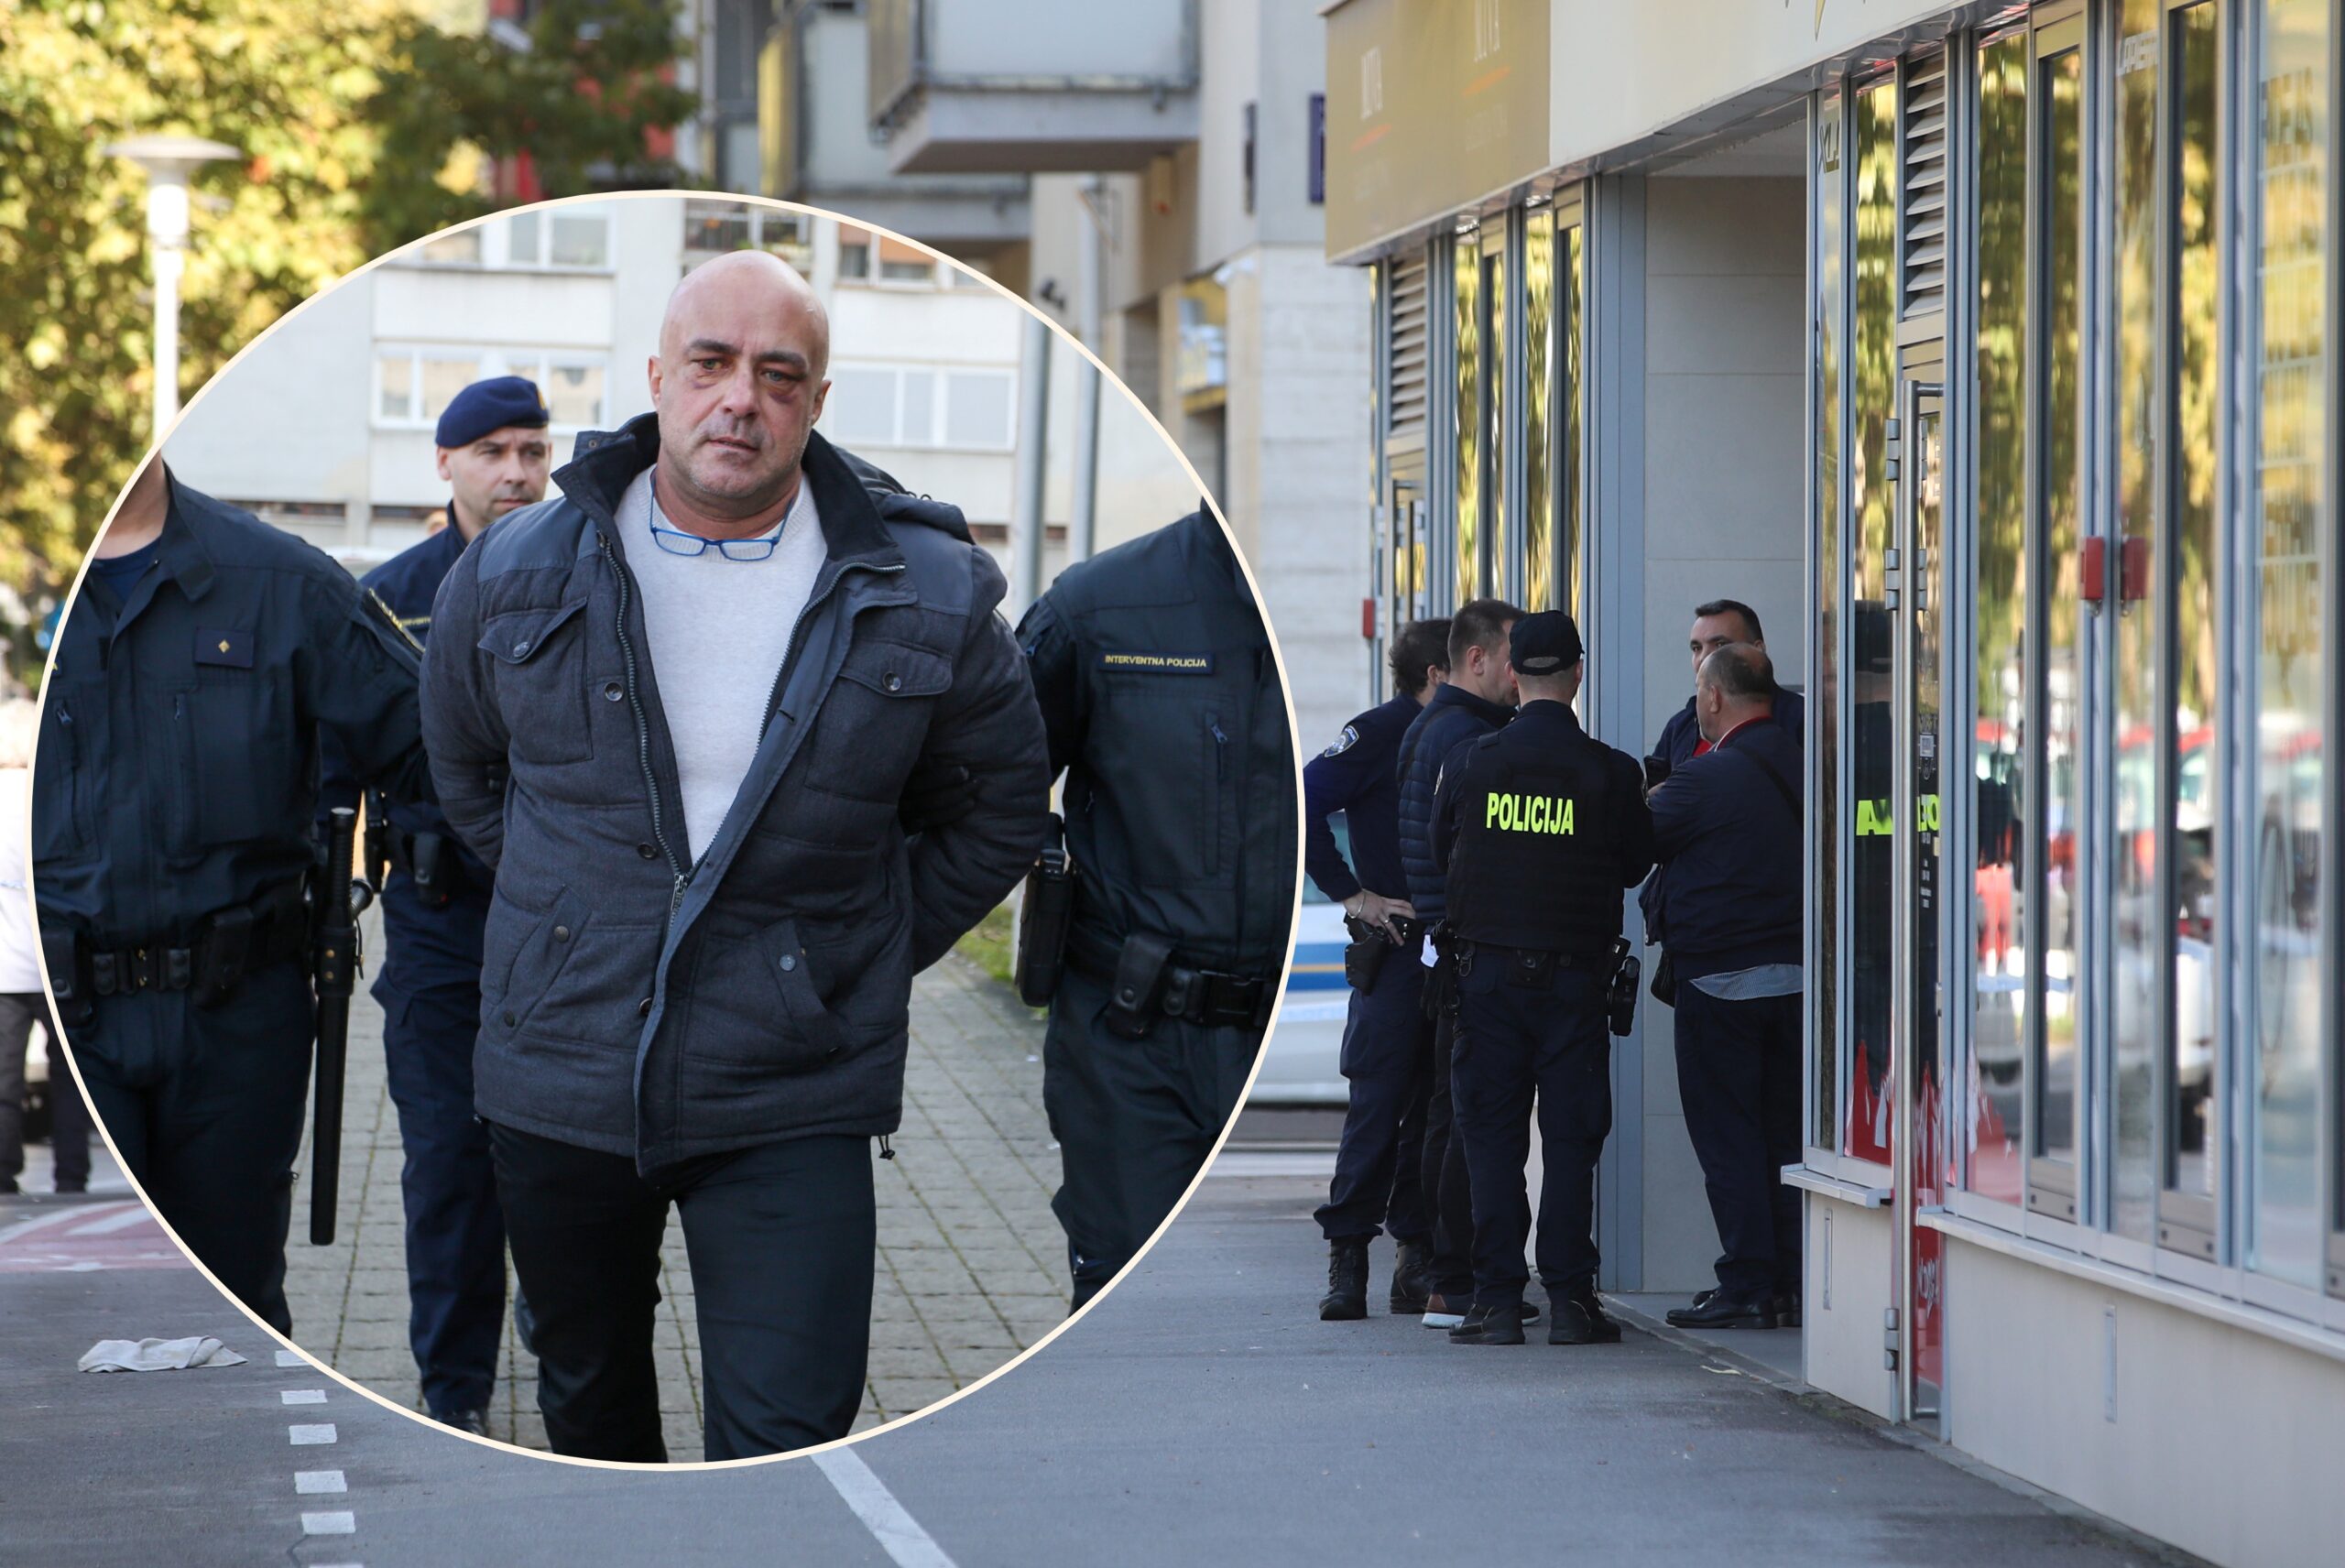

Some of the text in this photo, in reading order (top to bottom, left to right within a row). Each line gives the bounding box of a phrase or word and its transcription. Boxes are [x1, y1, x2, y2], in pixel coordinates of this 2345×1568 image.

[1105, 655, 1206, 667] INTERVENTNA POLICIJA
[1486, 792, 1574, 835] POLICIJA
